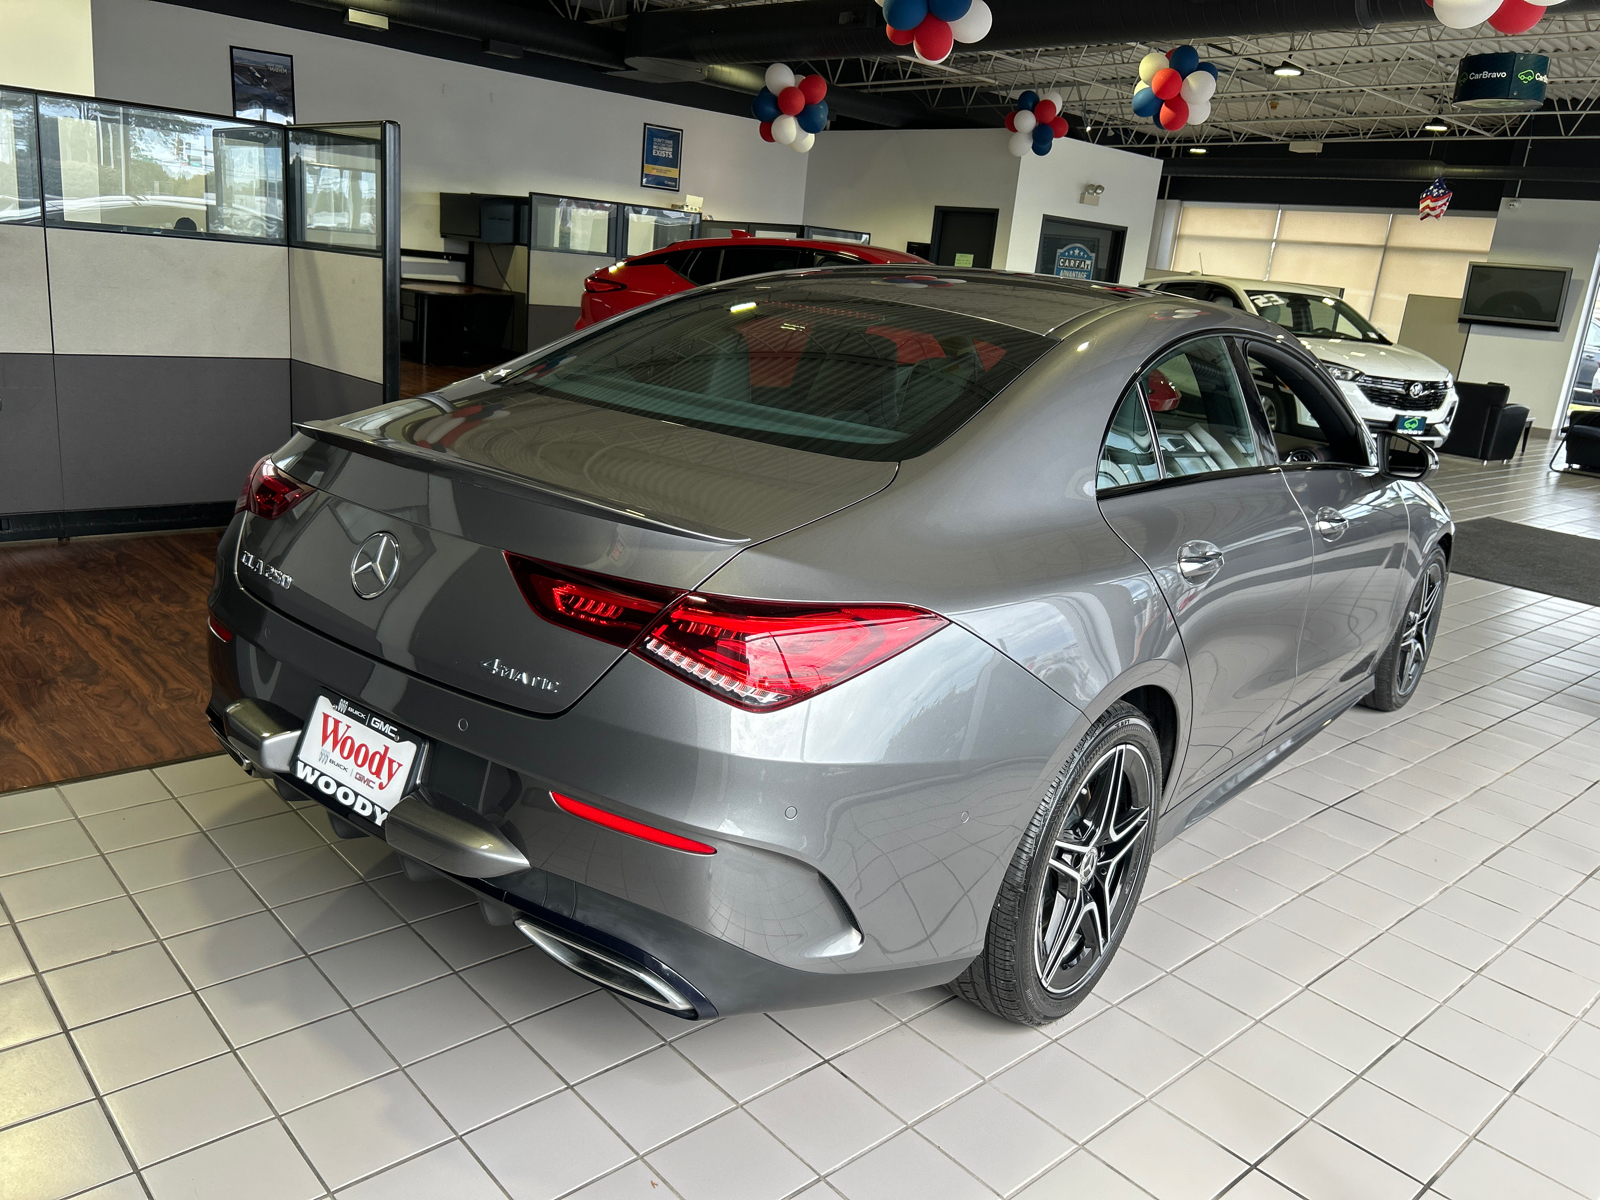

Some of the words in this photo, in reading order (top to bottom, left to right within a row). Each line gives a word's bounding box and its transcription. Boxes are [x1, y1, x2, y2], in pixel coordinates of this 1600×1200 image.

[1469, 71, 1507, 80] CarBravo
[1059, 258, 1091, 270] CARFAX
[1250, 293, 1285, 307] 23
[480, 658, 560, 693] 4MATIC
[347, 706, 366, 720] BUICK
[370, 716, 398, 737] GMC
[320, 711, 403, 790] Woody
[328, 758, 349, 773] BUICK
[354, 771, 376, 790] GMC
[296, 760, 389, 826] WOODY
